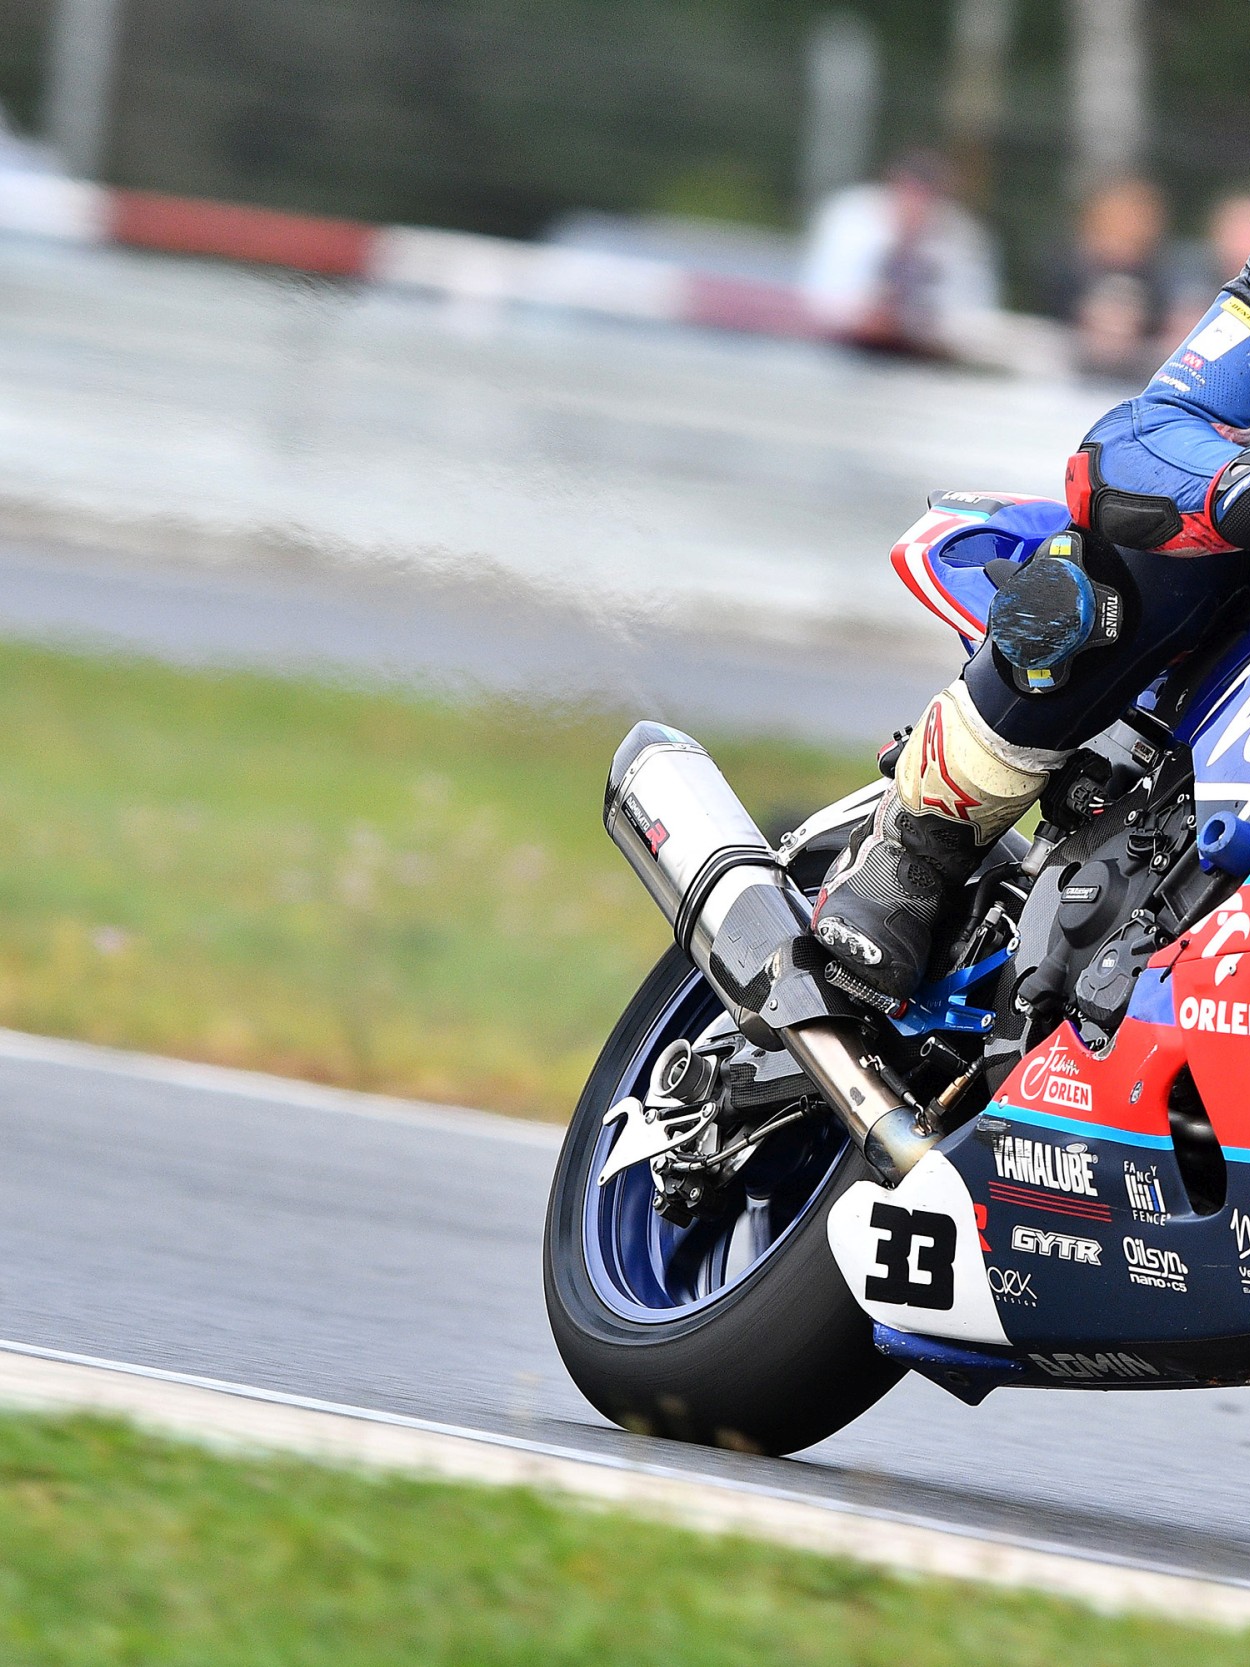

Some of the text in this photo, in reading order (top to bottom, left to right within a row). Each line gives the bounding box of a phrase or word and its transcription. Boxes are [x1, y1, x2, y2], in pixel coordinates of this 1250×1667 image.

[1105, 595, 1120, 639] TWINS
[1048, 1080, 1089, 1106] ORLEN
[1123, 1160, 1157, 1184] FANCY
[1132, 1209, 1167, 1227] FENCE
[1011, 1225, 1103, 1266] GYTR
